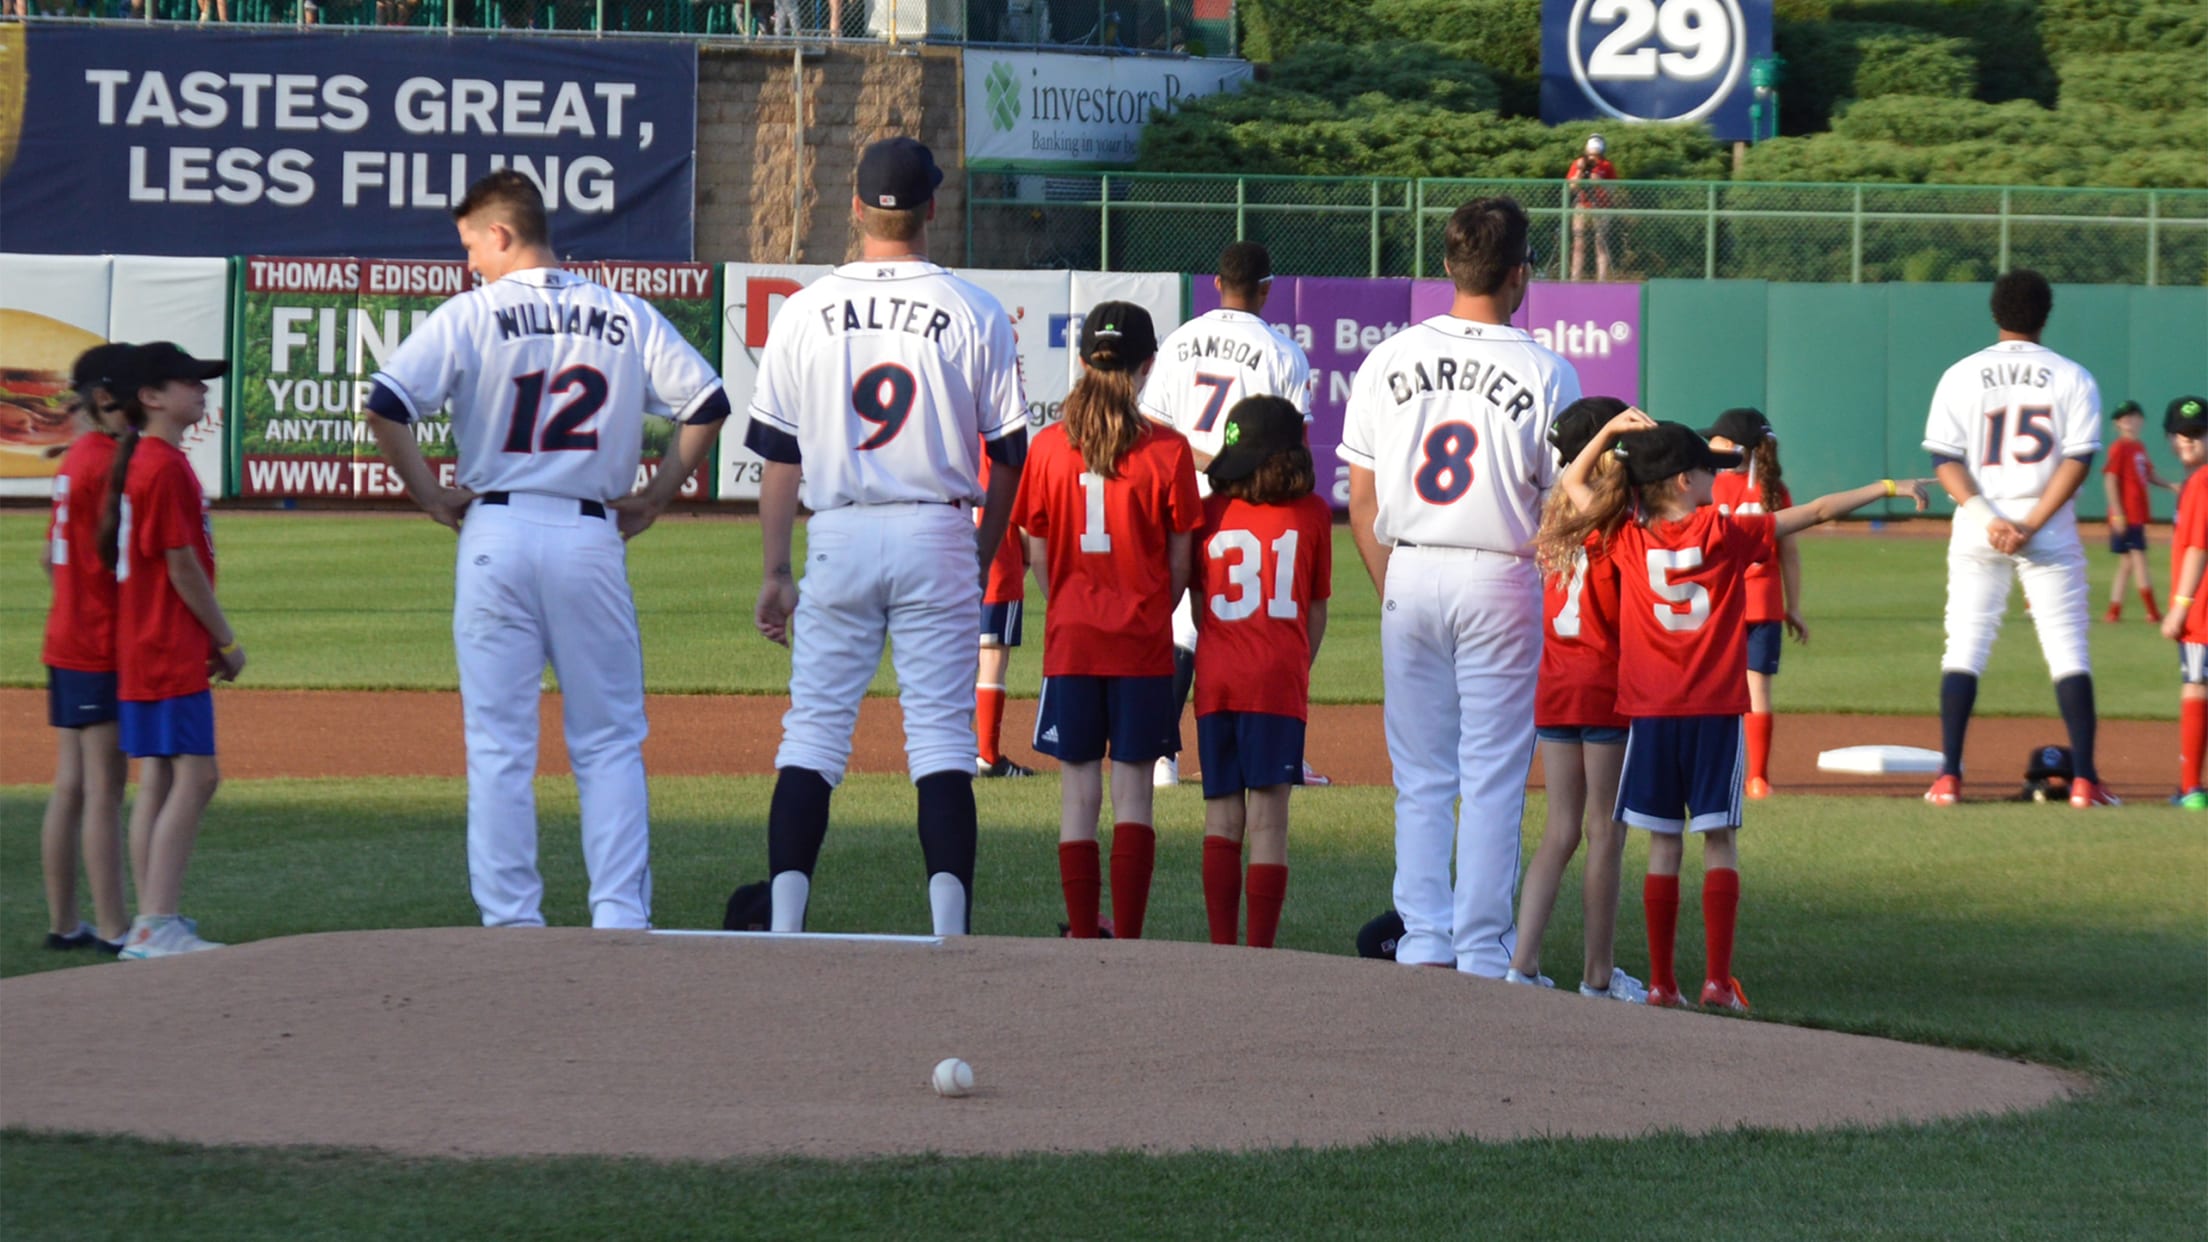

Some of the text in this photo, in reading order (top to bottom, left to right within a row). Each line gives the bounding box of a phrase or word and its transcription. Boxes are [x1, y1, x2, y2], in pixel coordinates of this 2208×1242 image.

[1587, 0, 1730, 80] 29
[85, 69, 654, 149] TASTES GREAT,
[1032, 130, 1079, 158] Banking
[1081, 132, 1093, 152] in
[1095, 138, 1120, 158] your
[129, 146, 615, 213] LESS FILLNG
[251, 262, 359, 289] THOMAS
[370, 265, 462, 292] EDISON
[560, 267, 708, 294] NIVERSITY
[494, 303, 628, 346] WILLIAMS
[820, 297, 951, 343] FALTER
[1177, 336, 1263, 371] GAMBOA
[1980, 363, 2052, 389] RIVAS
[501, 363, 609, 453] 12
[852, 361, 917, 451] 9
[1193, 371, 1236, 433] 7
[1387, 357, 1535, 423] BARBIER
[1414, 419, 1480, 506] 8
[1981, 404, 2055, 466] 15
[1079, 471, 1111, 553] 1
[1208, 529, 1298, 621] 31
[1646, 546, 1711, 632] 5
